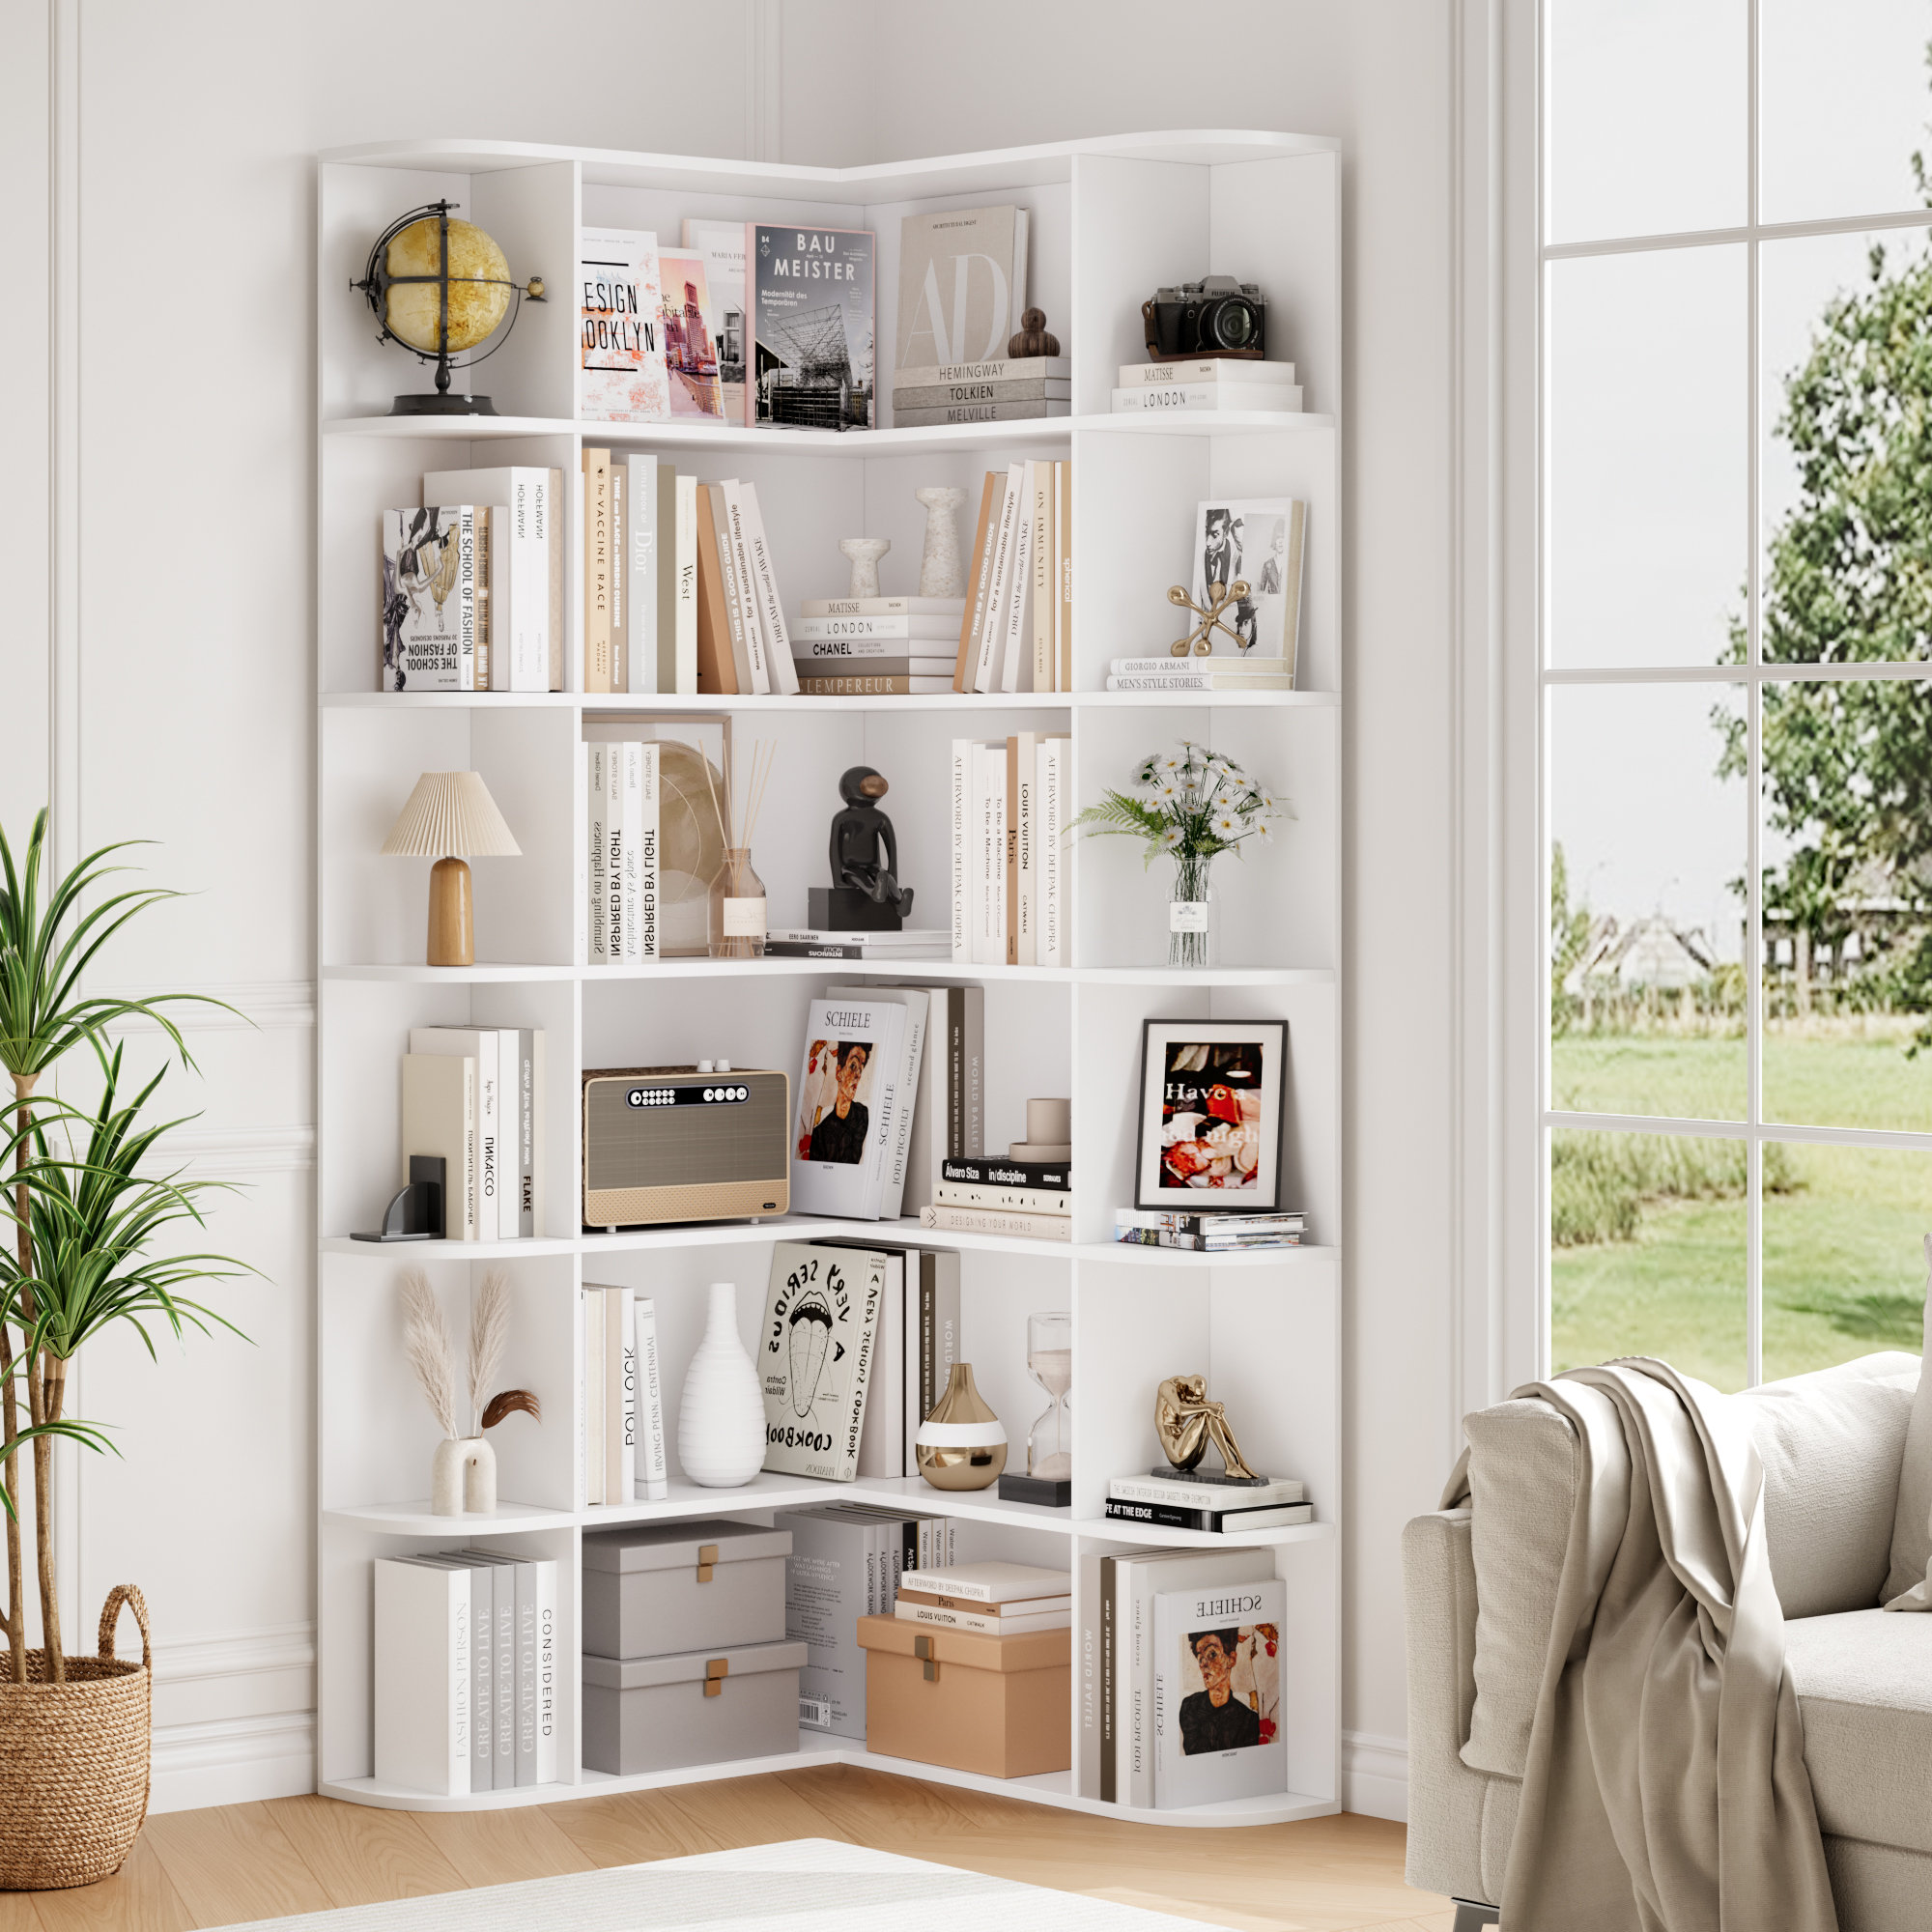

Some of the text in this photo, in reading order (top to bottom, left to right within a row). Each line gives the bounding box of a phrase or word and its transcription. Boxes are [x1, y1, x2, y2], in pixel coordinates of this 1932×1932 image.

[761, 235, 770, 243] B4
[797, 233, 836, 254] BAU
[774, 259, 855, 281] MEISTER
[584, 282, 638, 314] ESIGN
[761, 289, 808, 300] Modernität des
[900, 253, 1009, 368] AD
[581, 319, 655, 352] OOKLYN
[939, 363, 1005, 381] HEMINGWAY
[1144, 367, 1174, 382] MATISSE
[950, 385, 994, 400] TOLKIEN
[1144, 391, 1186, 408] LONDON
[948, 406, 996, 422] MELVILLE
[1037, 491, 1044, 509] ON
[462, 512, 473, 535] THE
[597, 500, 605, 565] VACCINE
[731, 504, 741, 540] lifestyle
[995, 531, 1009, 586] sustainable
[1004, 490, 1015, 530] lifestyle
[462, 537, 473, 584] SCHOOL
[635, 530, 653, 575] Dior
[753, 537, 767, 573] AWAKE
[737, 542, 750, 595] sustainable
[972, 522, 996, 637] THIS IS A GOOD GUIDE
[1063, 557, 1071, 602] spherical
[597, 574, 606, 611] RACE
[682, 564, 693, 601] West
[721, 532, 743, 642] THIS IS A GOOD GUIDE
[762, 574, 772, 592] world
[462, 587, 473, 602] OF
[462, 606, 473, 655] FASHION
[769, 606, 783, 643] DREAM
[827, 622, 873, 634] LONDON
[408, 643, 457, 656] OF FASHION
[813, 643, 852, 656] CHANEL
[406, 657, 457, 671] THE SCHOOL
[1125, 661, 1190, 671] GIORGIO ARMANI
[1117, 678, 1203, 689] MEN'S STYLE STORIES
[985, 797, 991, 809] To
[985, 812, 991, 824] Be
[955, 834, 962, 849] BY
[1009, 829, 1017, 864] Paris
[1049, 836, 1055, 851] BY
[825, 1011, 871, 1029] SCHIELE
[906, 1023, 919, 1086] second glance
[1165, 1083, 1246, 1101] Have a
[879, 1083, 894, 1147] SCHIELE
[892, 1107, 909, 1185] JODI PICOULT
[485, 1137, 494, 1197] ПИКАССО
[945, 1163, 966, 1179] Álvaro
[966, 1166, 980, 1180] Siza
[989, 1168, 1026, 1184] in/discipline
[523, 1176, 531, 1212] FLAKE
[951, 1215, 1032, 1232] DESIGNING YOUR WORLD
[647, 1335, 658, 1398] CENTENNIAL
[654, 1433, 664, 1471] IRVING
[1113, 1504, 1122, 1516] AT
[1122, 1505, 1134, 1517] THE
[1135, 1507, 1152, 1520] EDGE
[938, 1596, 954, 1608] Paris
[917, 1609, 933, 1620] LOUIS
[933, 1612, 956, 1624] VUITTON
[478, 1607, 489, 1758] CREATE TO LIVE
[542, 1609, 552, 1736] CONSIDERED
